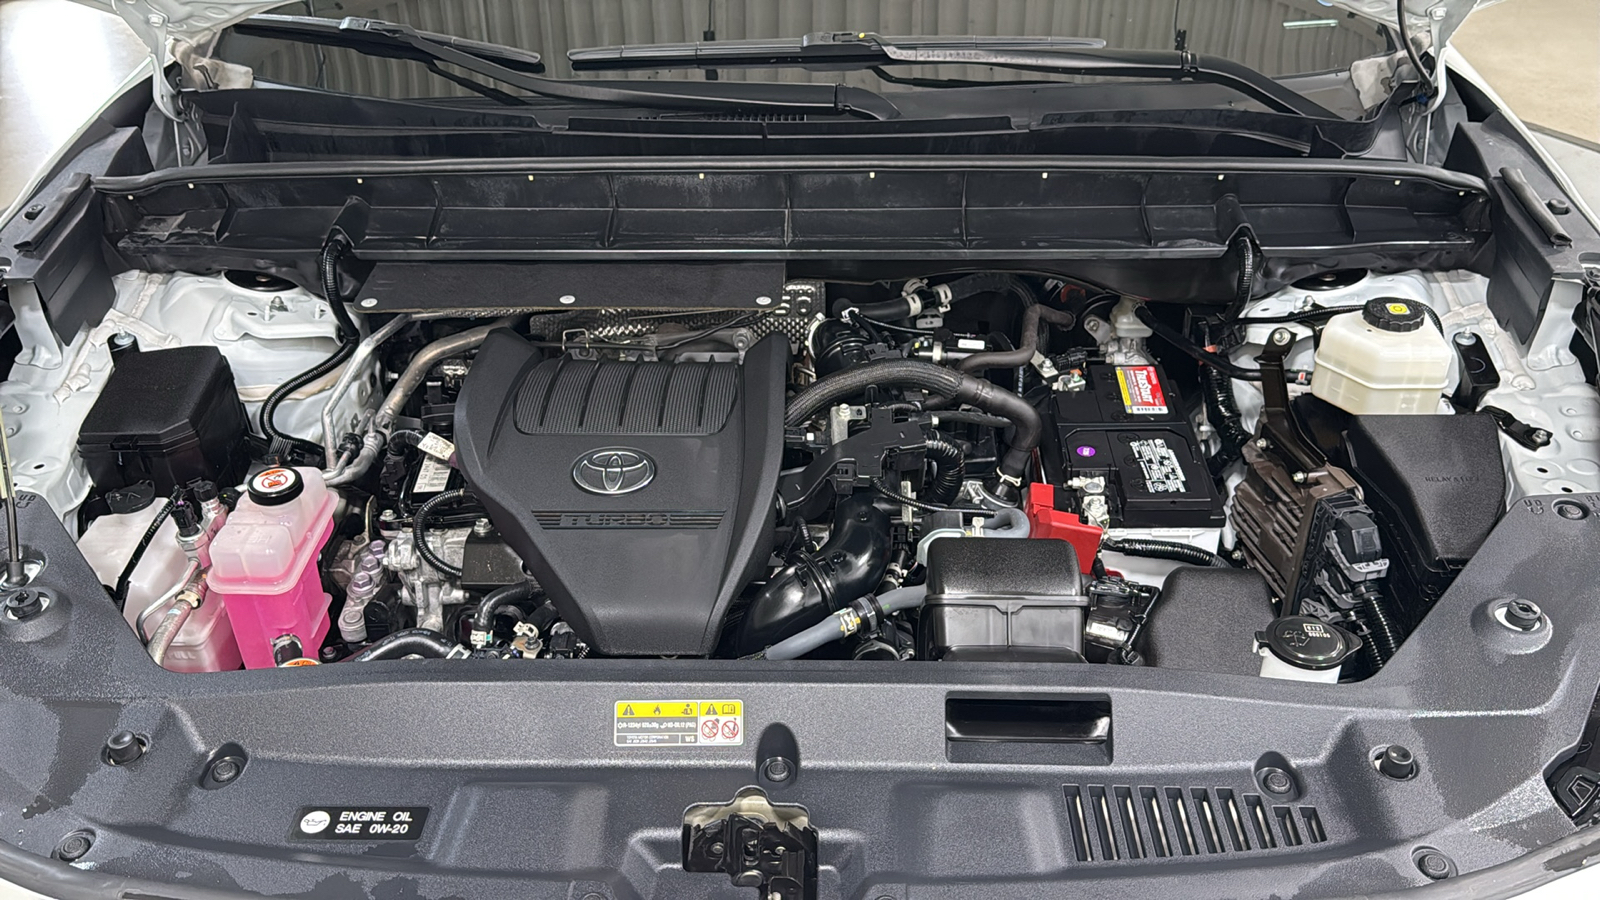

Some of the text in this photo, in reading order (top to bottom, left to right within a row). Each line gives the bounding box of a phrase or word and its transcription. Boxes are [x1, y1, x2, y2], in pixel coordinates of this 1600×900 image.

[564, 513, 668, 526] TURBO
[339, 811, 413, 822] ENGINE OIL
[335, 823, 408, 834] SAE 0W-20
